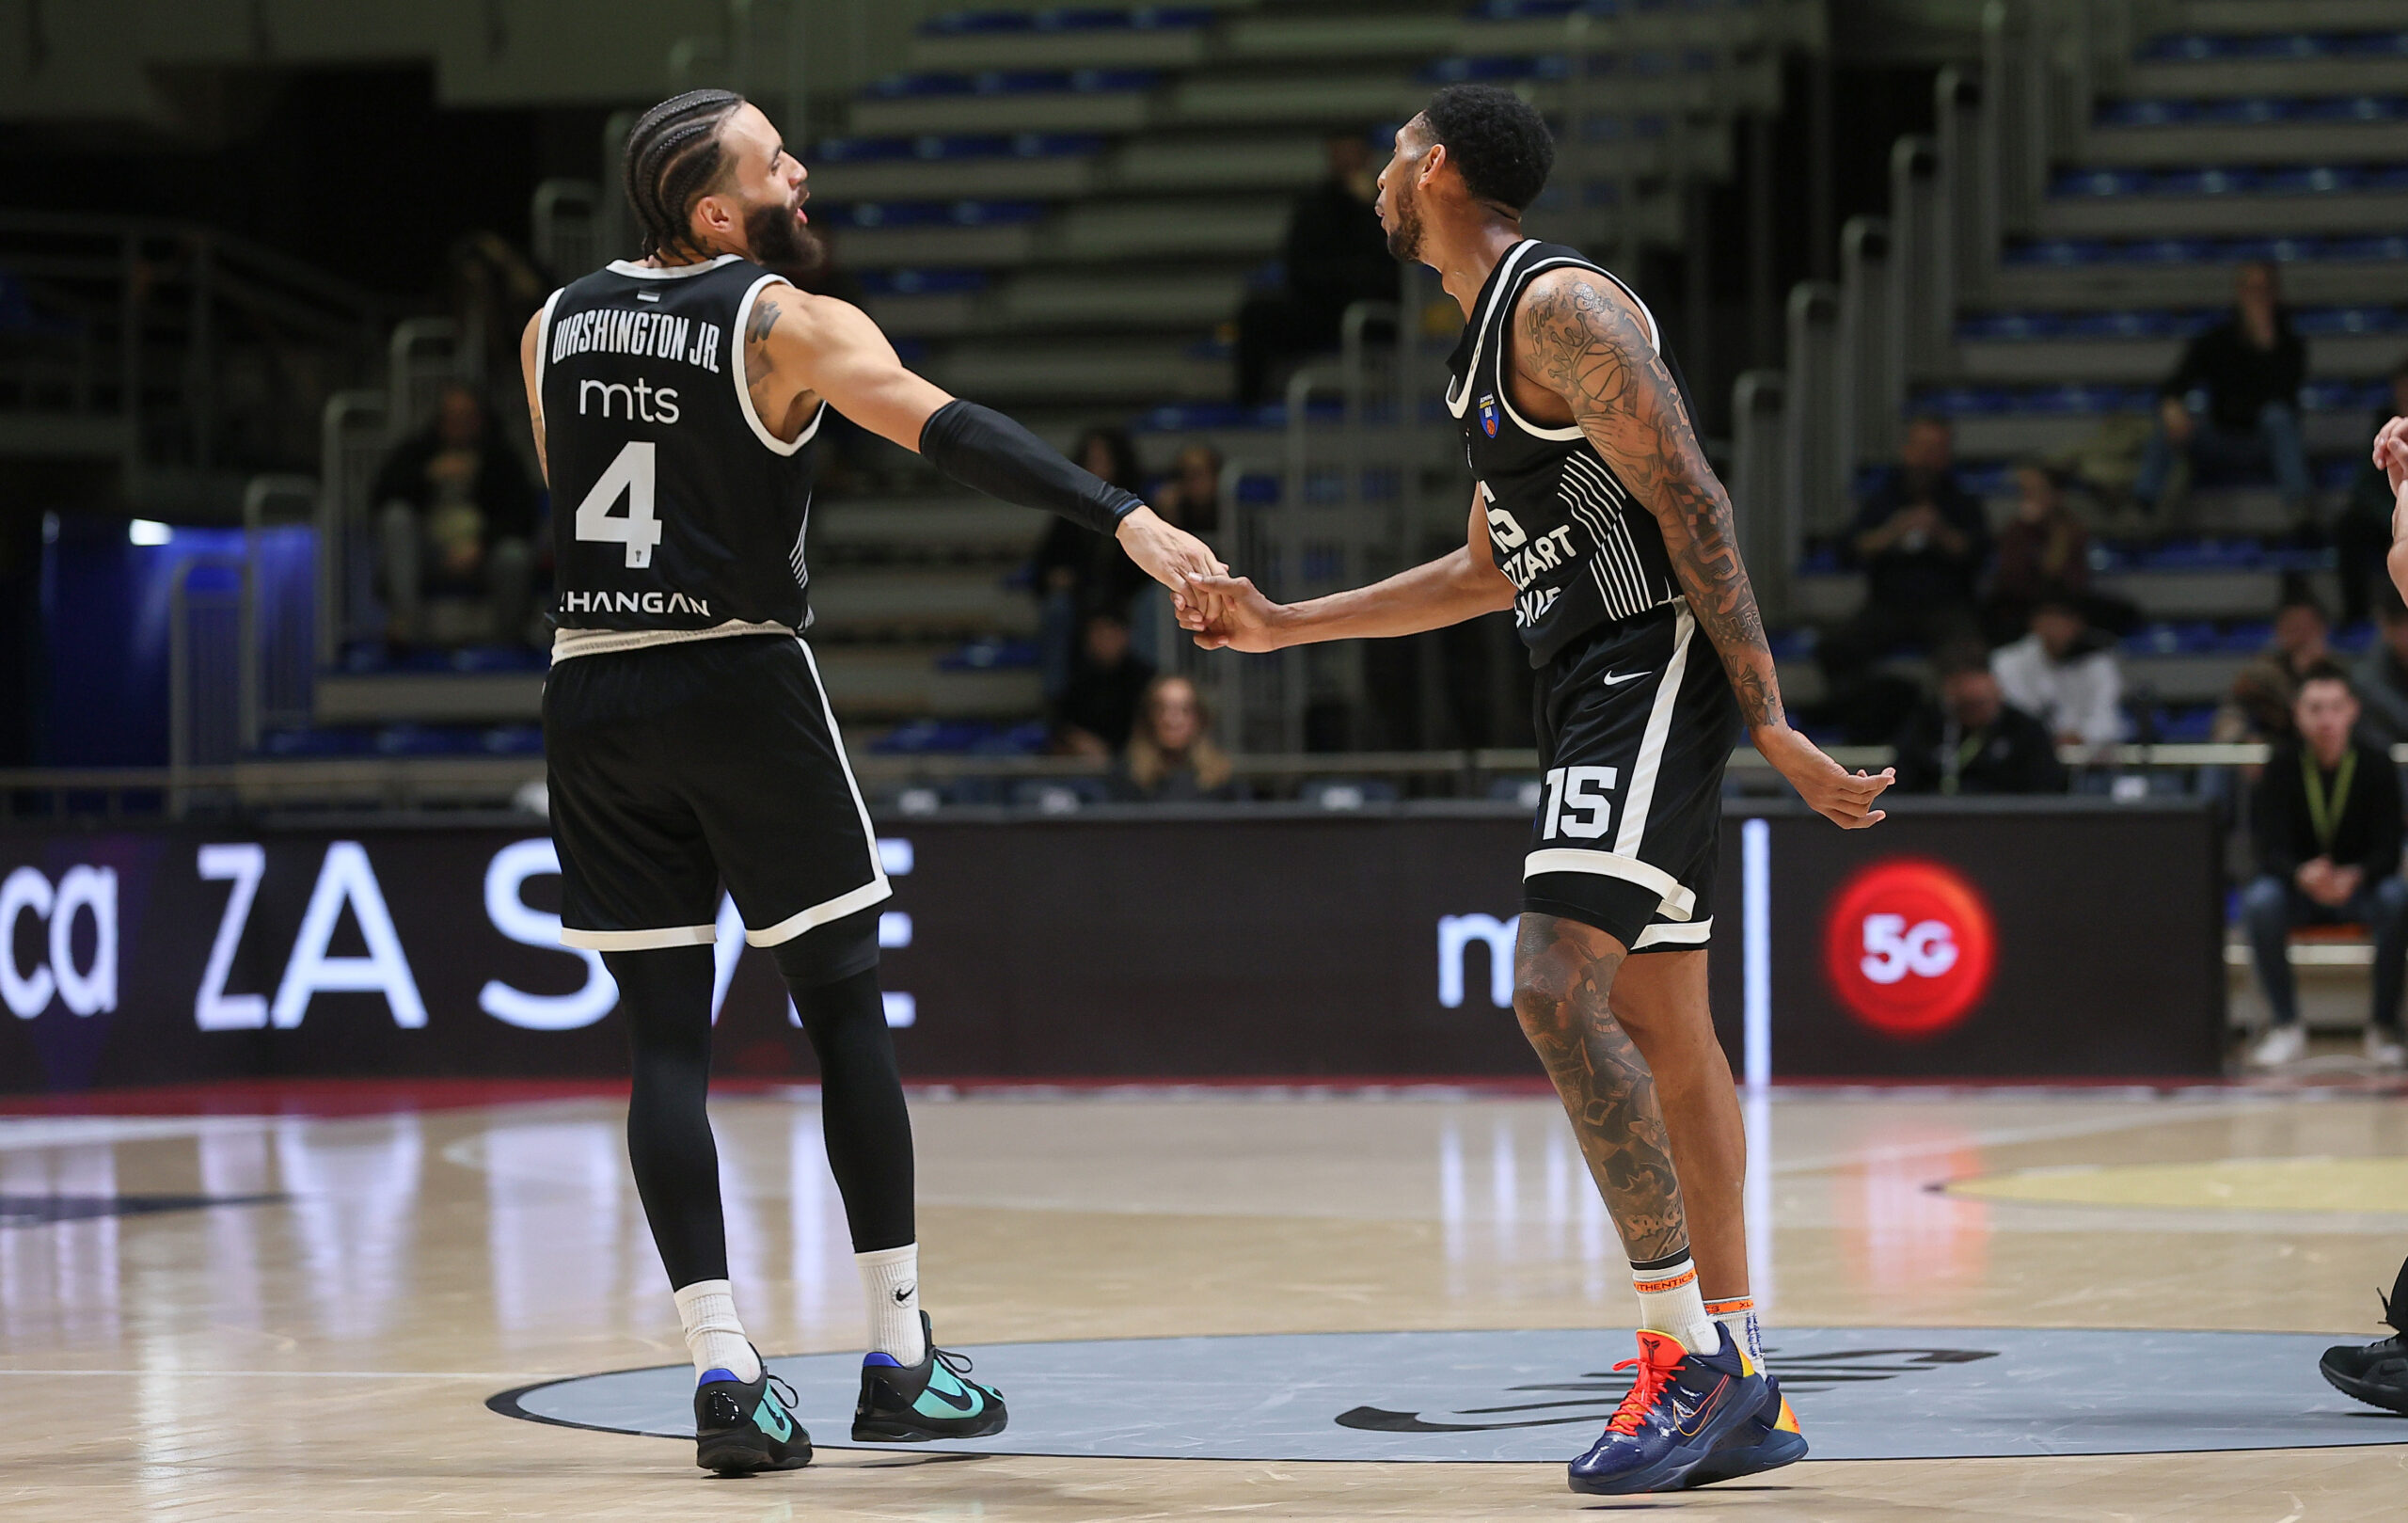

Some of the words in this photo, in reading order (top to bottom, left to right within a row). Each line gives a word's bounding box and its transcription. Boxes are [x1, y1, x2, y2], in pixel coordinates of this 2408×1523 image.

[552, 309, 689, 365] WASHINGTON
[579, 377, 680, 424] mts
[576, 440, 662, 569] 4
[1480, 480, 1528, 554] 5
[1500, 524, 1576, 592] ZZART
[559, 590, 711, 617] HANGAN
[1543, 766, 1618, 841] 15
[194, 840, 429, 1031] ZA
[1860, 912, 1958, 985] 5G
